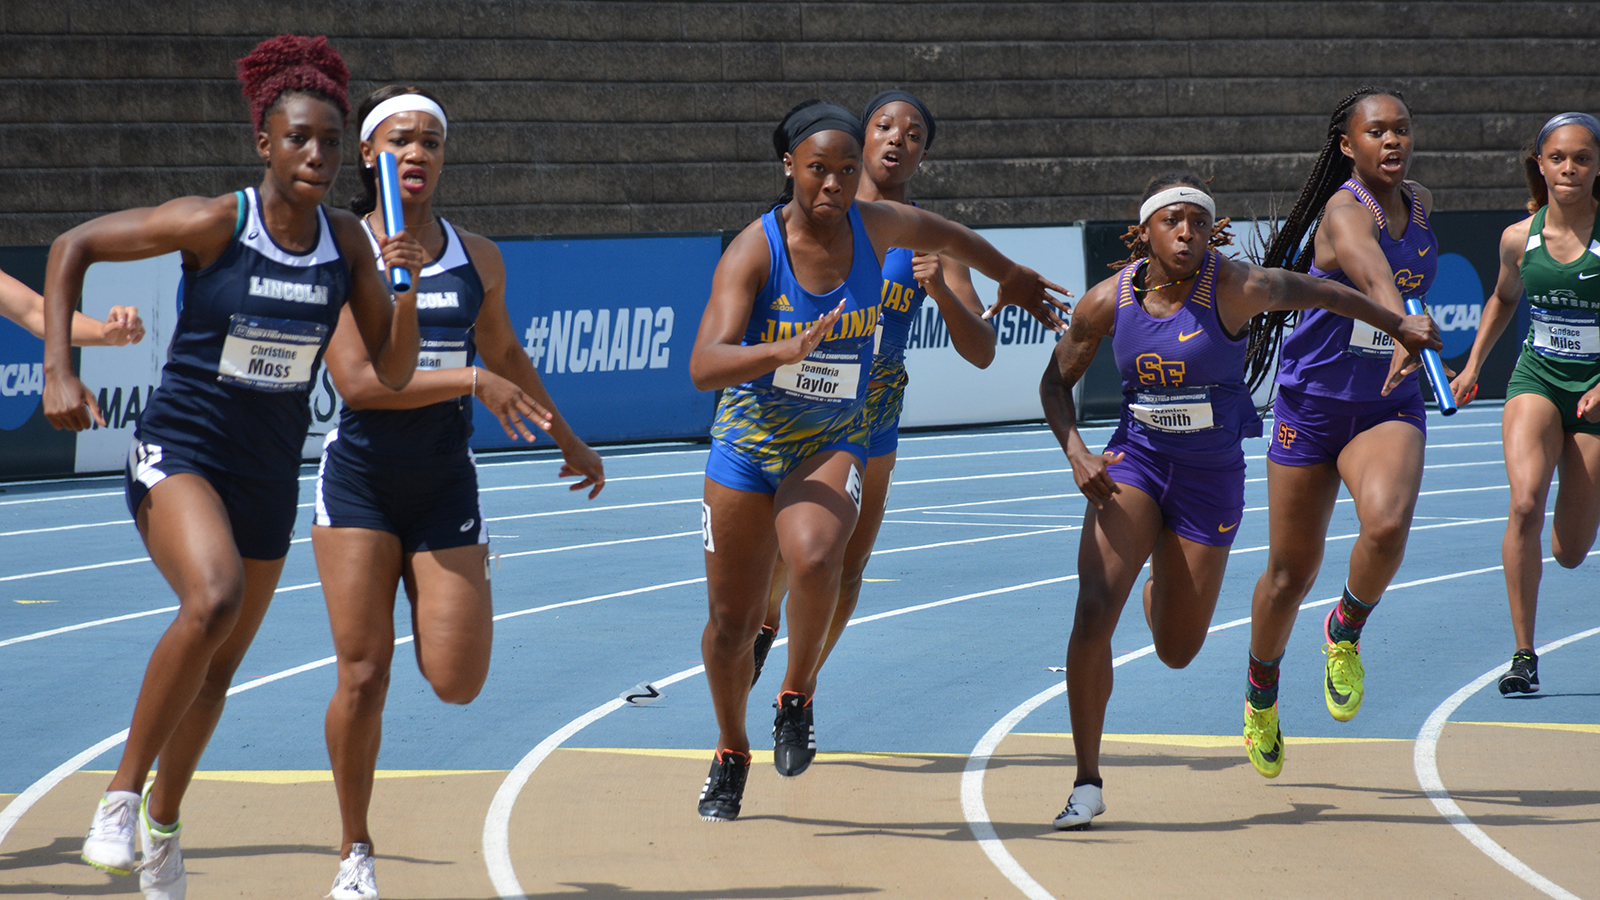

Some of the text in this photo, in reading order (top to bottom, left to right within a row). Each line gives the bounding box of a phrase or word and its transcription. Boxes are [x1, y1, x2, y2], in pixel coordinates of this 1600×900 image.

[248, 275, 329, 305] LINCOLN
[769, 304, 795, 312] adidas
[1533, 295, 1600, 309] EASTERN
[524, 306, 675, 374] #NCAAD2
[1550, 335, 1581, 350] Miles
[250, 344, 297, 360] Christine
[247, 358, 292, 379] Moss
[800, 363, 839, 377] Teandria
[1135, 353, 1186, 387] SF
[795, 373, 840, 394] Taylor
[1150, 413, 1191, 427] Smith
[1277, 421, 1297, 448] SF
